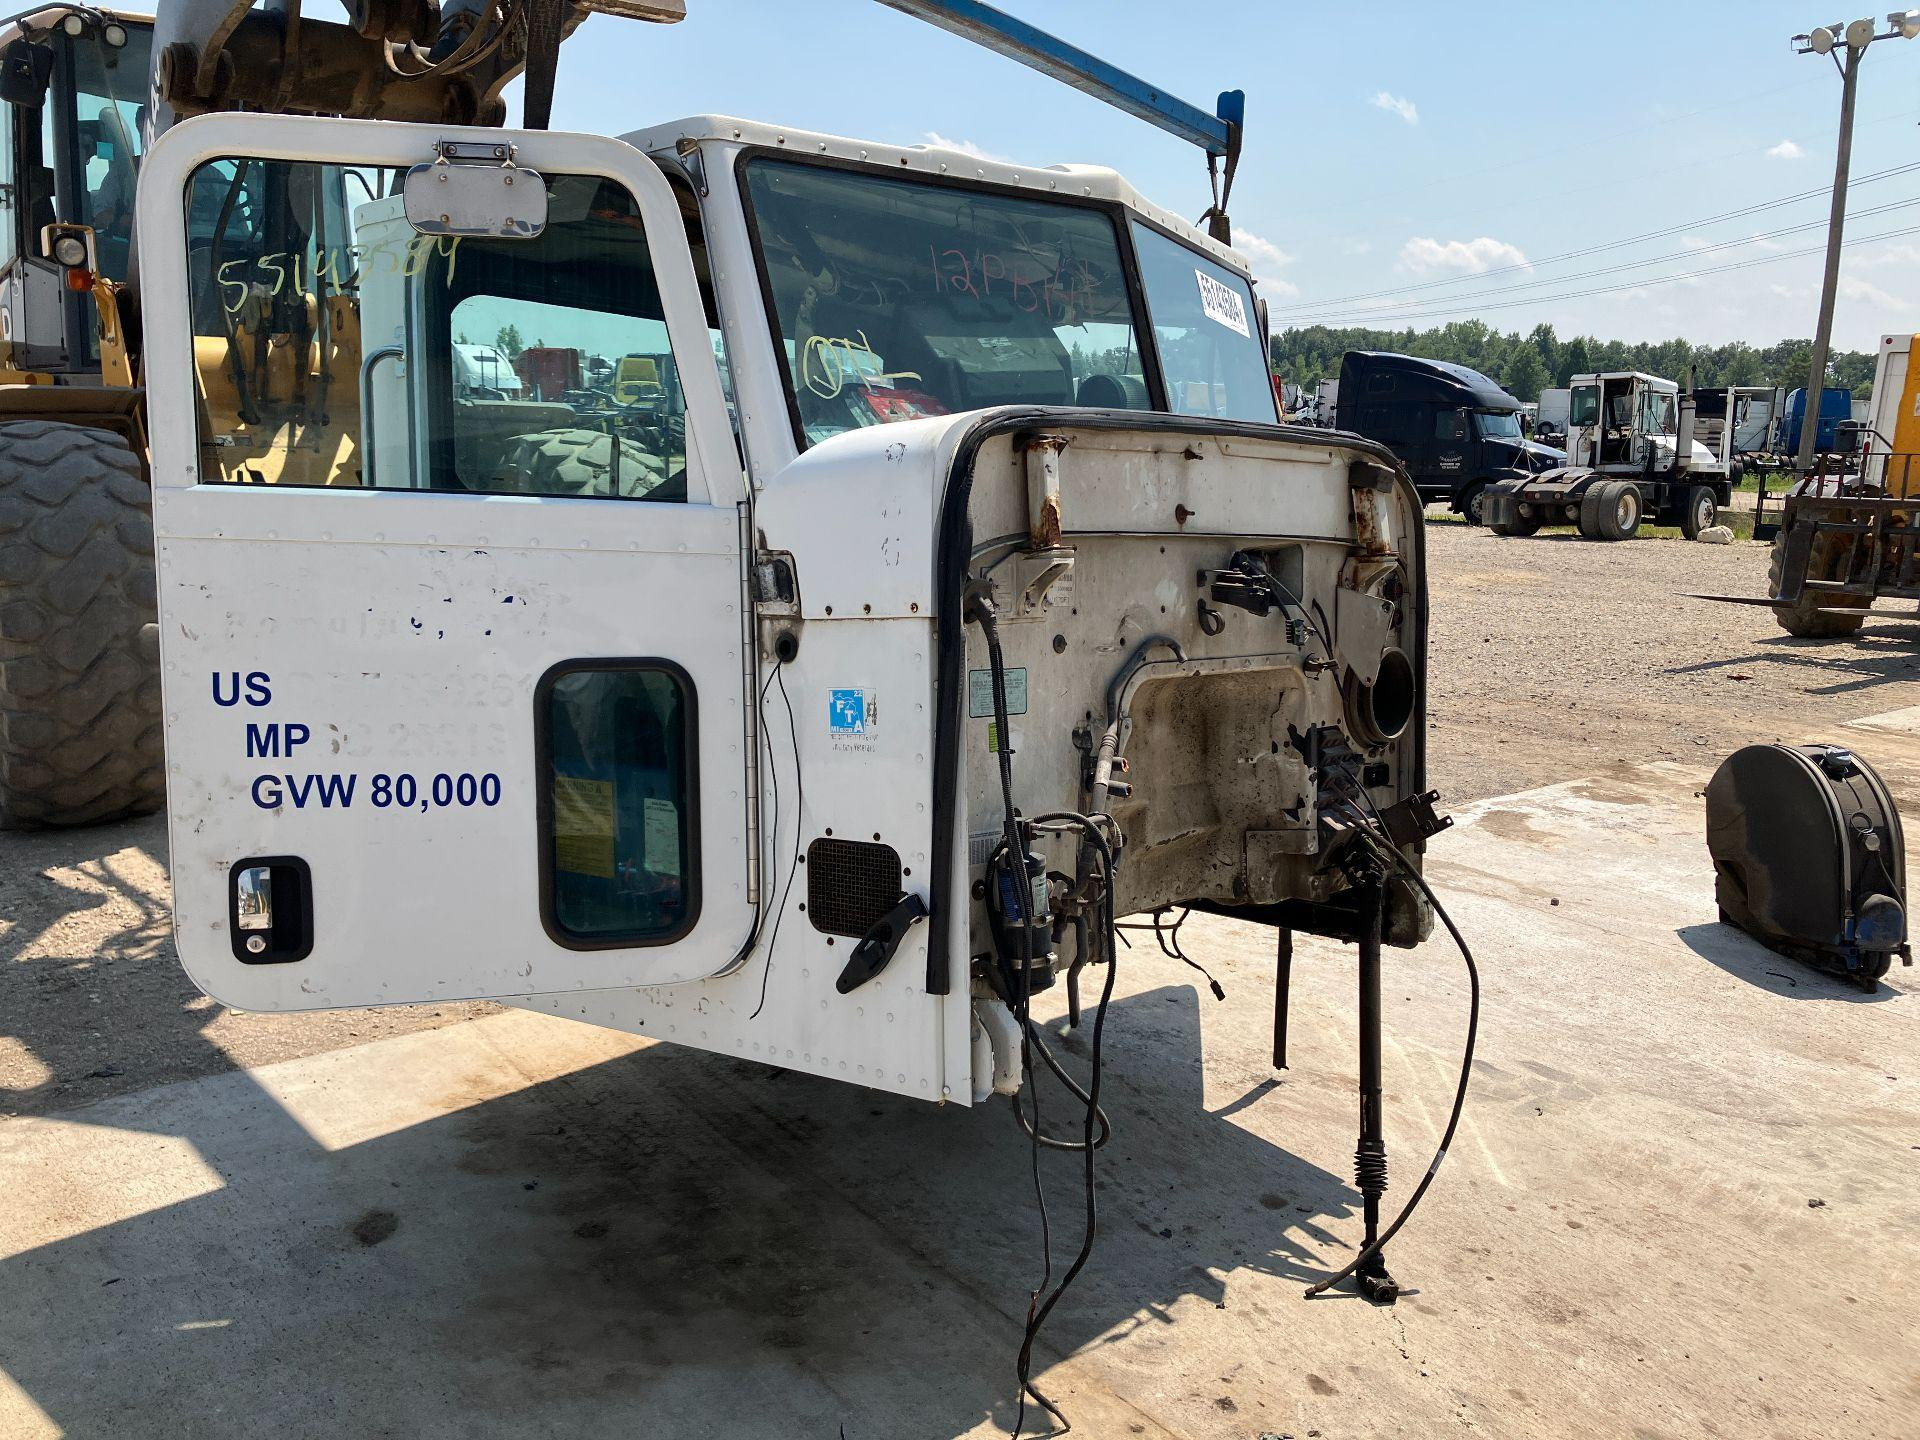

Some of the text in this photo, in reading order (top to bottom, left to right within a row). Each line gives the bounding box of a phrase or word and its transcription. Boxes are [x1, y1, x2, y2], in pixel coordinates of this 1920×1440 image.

[212, 671, 272, 707] US
[246, 723, 310, 758] MP
[251, 773, 501, 813] GVW 80,000
